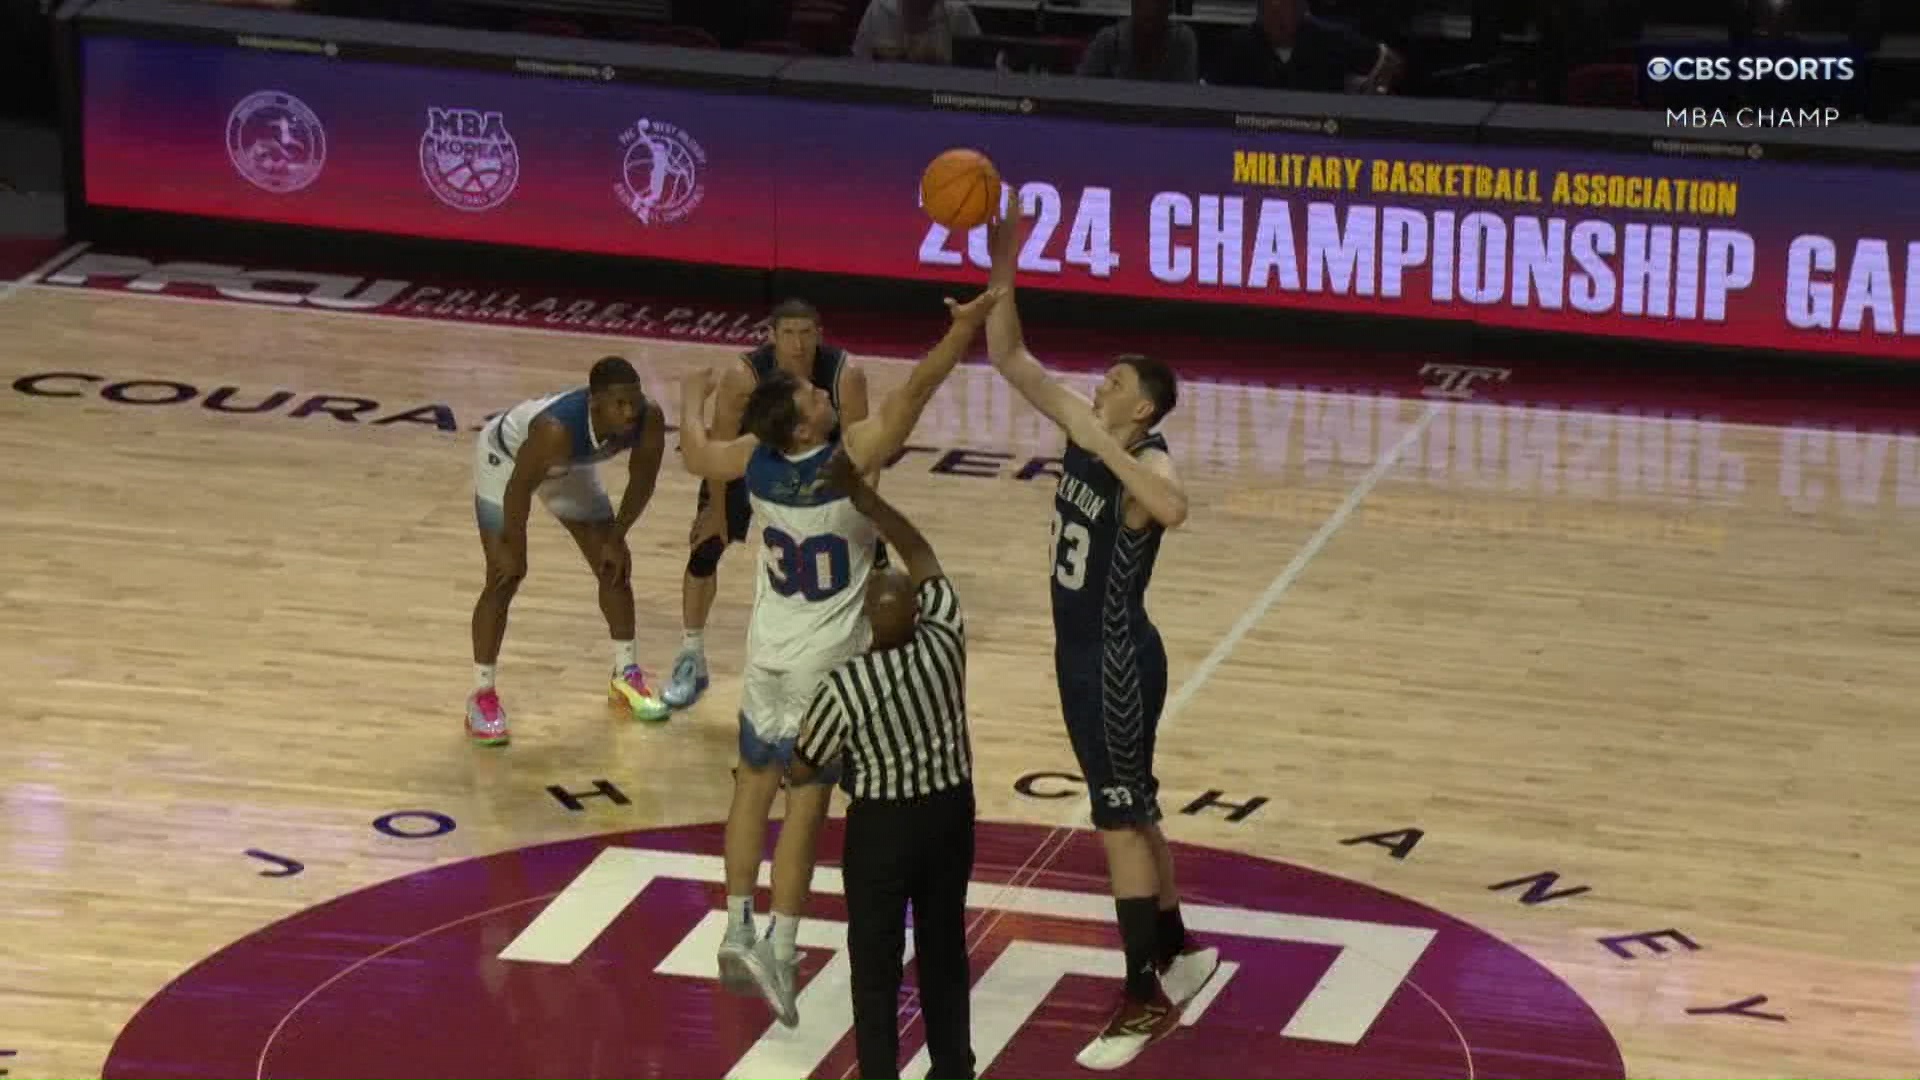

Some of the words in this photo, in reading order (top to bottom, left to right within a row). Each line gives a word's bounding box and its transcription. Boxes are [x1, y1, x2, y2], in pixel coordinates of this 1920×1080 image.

[428, 107, 509, 144] MBA
[1233, 150, 1363, 190] MILITARY
[1371, 159, 1542, 202] BASKETBALL
[1552, 171, 1738, 216] ASSOCIATION
[1148, 191, 1756, 322] CHAMPIONSHIP
[11, 372, 507, 432] COURA
[763, 526, 850, 602] 30
